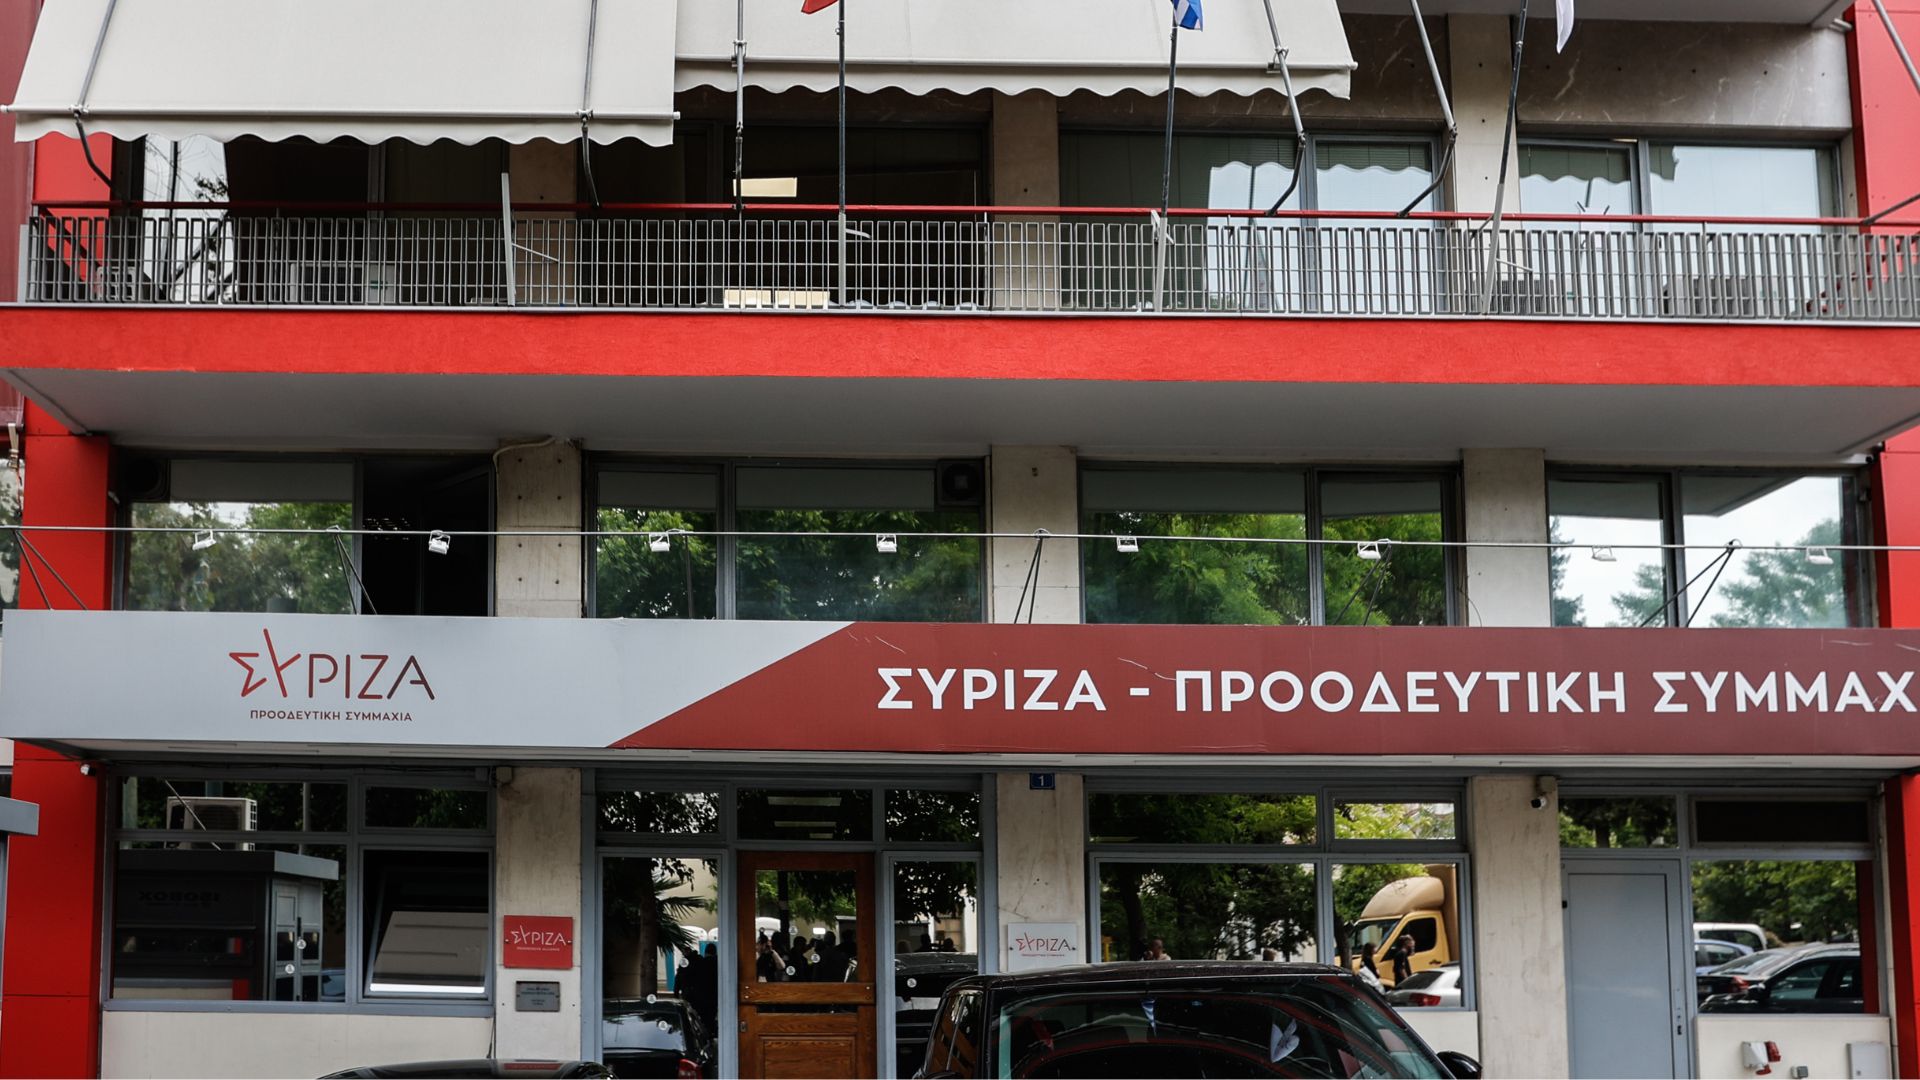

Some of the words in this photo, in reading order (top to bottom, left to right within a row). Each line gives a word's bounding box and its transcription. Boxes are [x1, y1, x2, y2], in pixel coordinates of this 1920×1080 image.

[229, 628, 435, 700] ΣΥΡΙΖΑ
[877, 668, 1107, 710] ΣΥΡΙΖΑ
[1129, 687, 1150, 696] -
[1175, 670, 1626, 713] ΠΡΟΟΔΕΥΤΙΚΗ
[1652, 671, 1919, 713] ΣΥΜΜΑΧ
[250, 709, 341, 721] ΠΡΟΟΔΕΥΤΙΚΗ
[345, 711, 413, 722] ΣΥΜΜΑΧΙΑ
[510, 924, 567, 946] ΣΥΡΙΖΑ
[1015, 932, 1072, 952] ΣΥΡΙΖΑ
